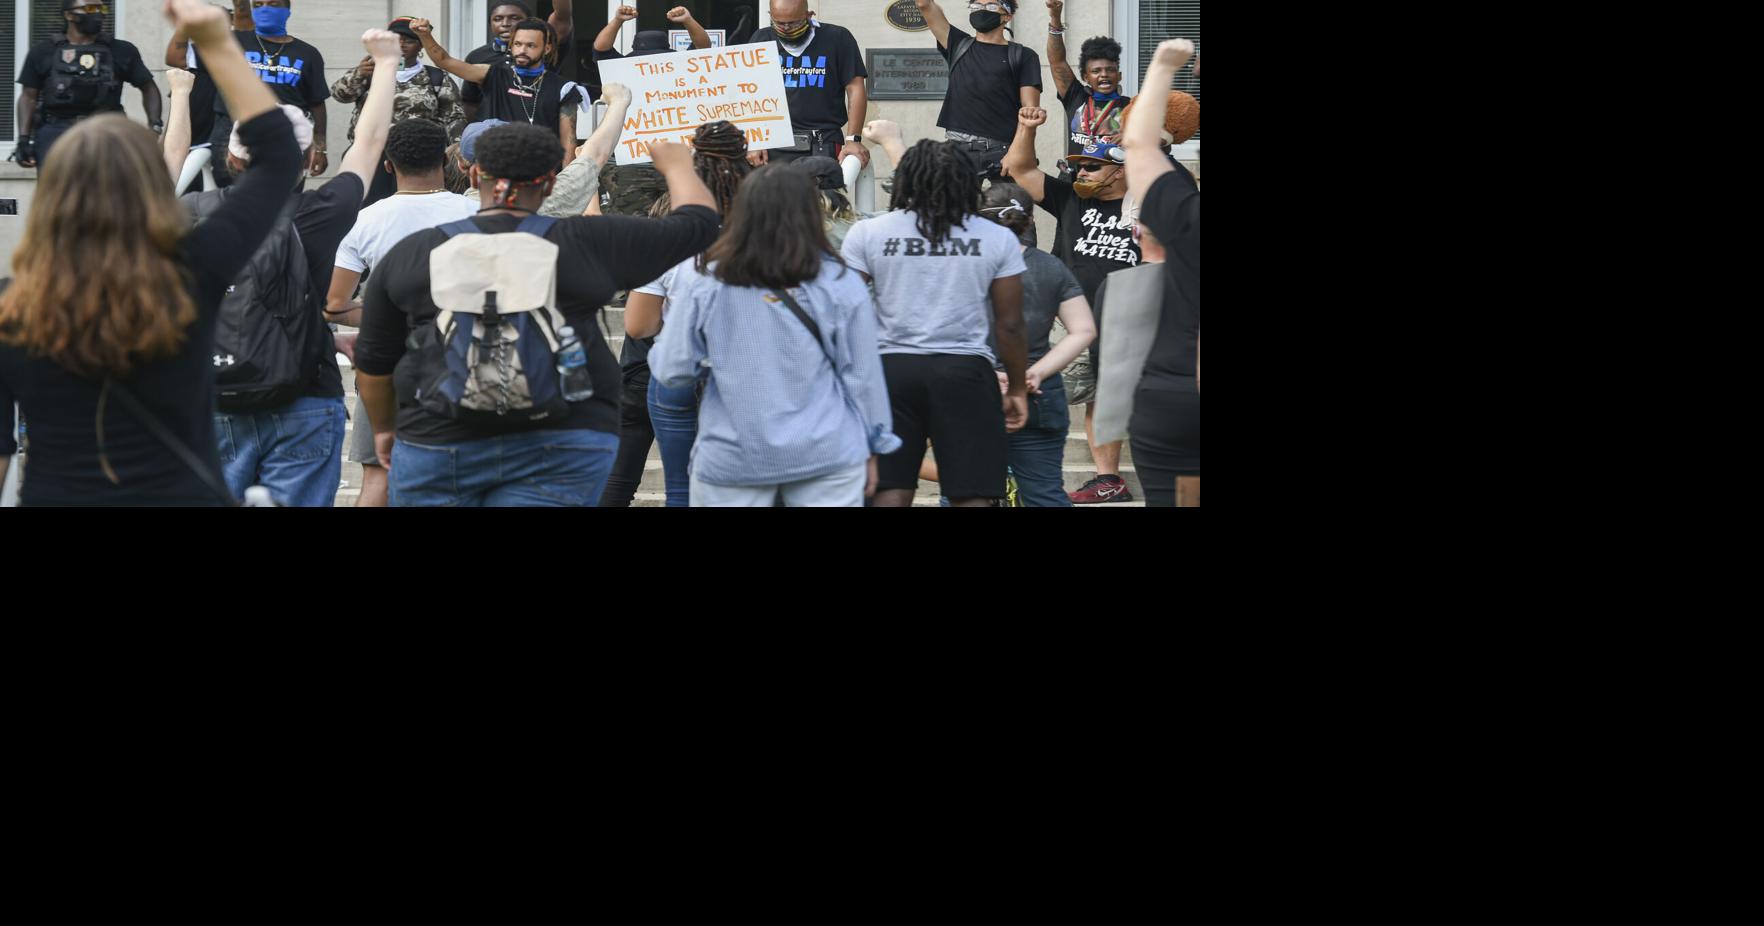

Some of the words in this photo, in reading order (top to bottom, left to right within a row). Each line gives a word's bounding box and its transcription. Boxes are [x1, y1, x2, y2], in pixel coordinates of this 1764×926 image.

[687, 48, 770, 73] STATUE
[779, 55, 827, 88] LM
[675, 78, 686, 87] IS
[699, 75, 708, 84] A
[645, 85, 727, 104] MONUMENT
[737, 83, 758, 94] TO
[696, 97, 779, 122] SUPREMACY
[622, 138, 668, 158] TAK
[883, 237, 982, 257] #BLM
[1086, 226, 1130, 249] Lives
[1073, 236, 1138, 267] MATTER
